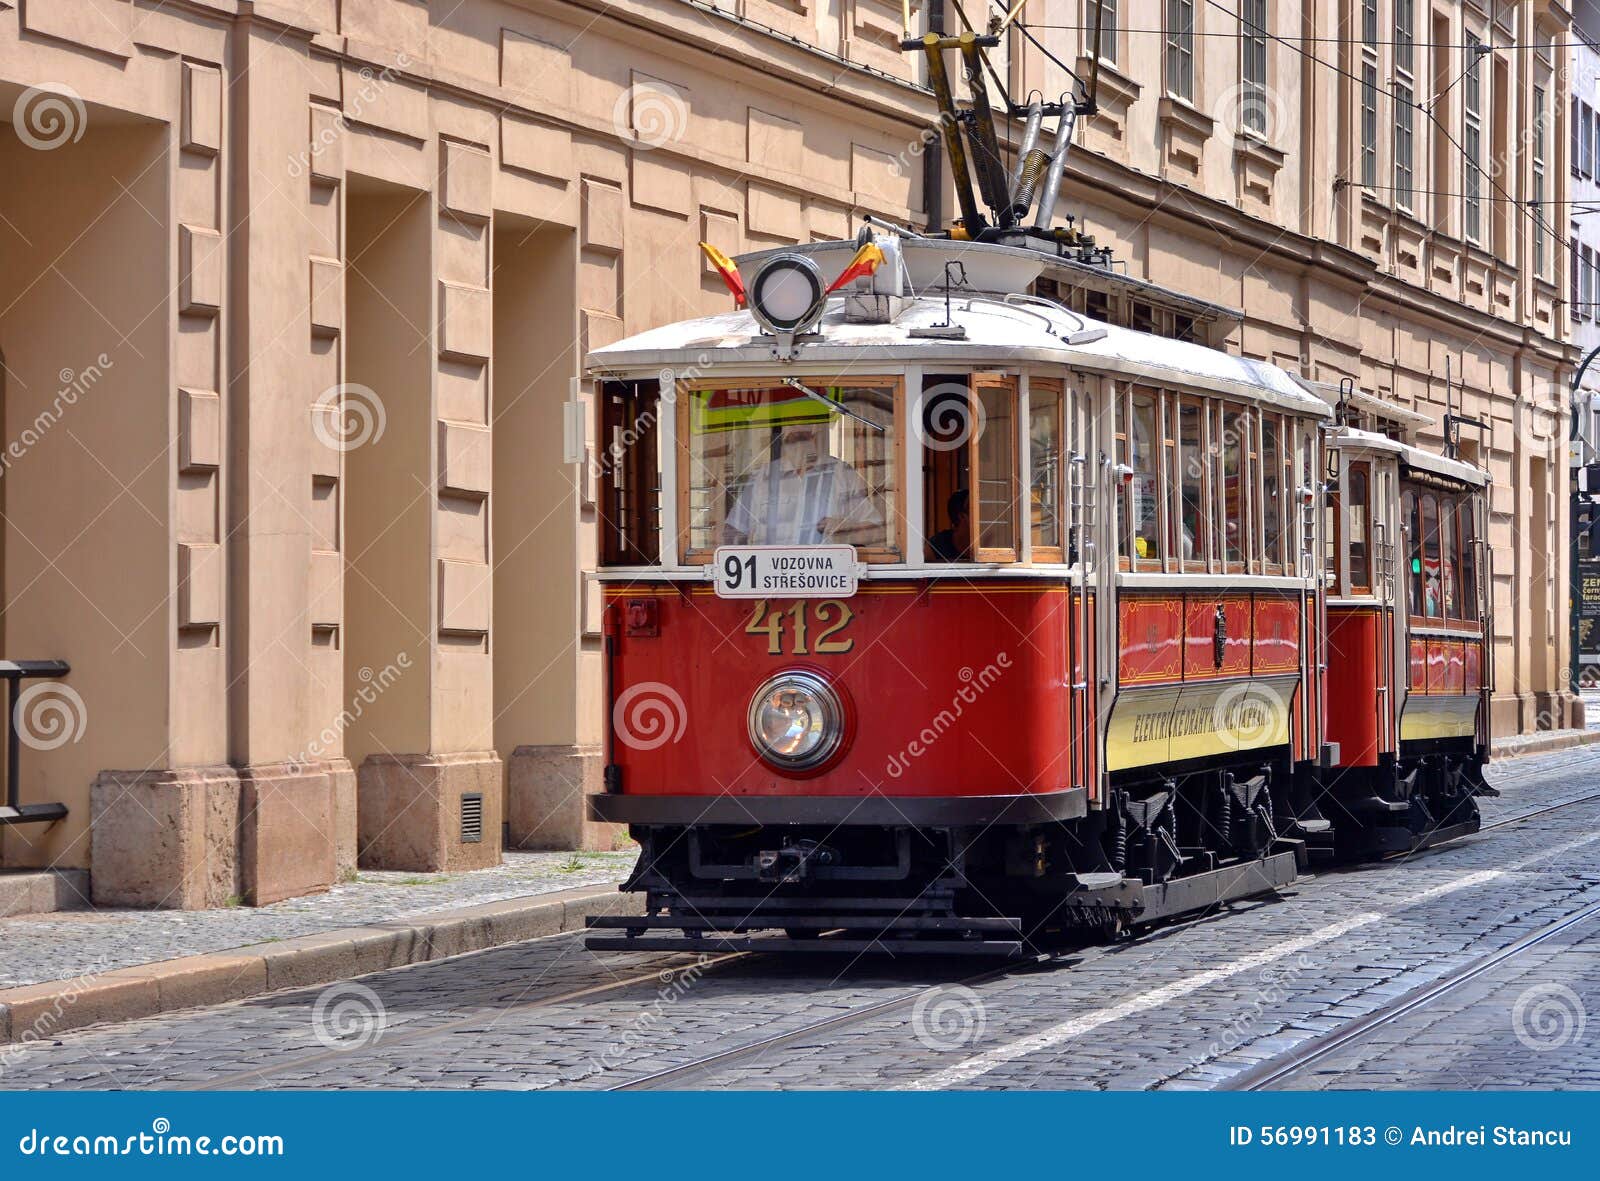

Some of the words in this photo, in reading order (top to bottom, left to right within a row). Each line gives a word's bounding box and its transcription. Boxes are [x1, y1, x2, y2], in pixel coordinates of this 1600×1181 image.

[725, 555, 757, 589] 91
[772, 557, 833, 570] VOZOVNA
[764, 573, 847, 589] STŘEŠOVICE
[745, 599, 854, 655] 412
